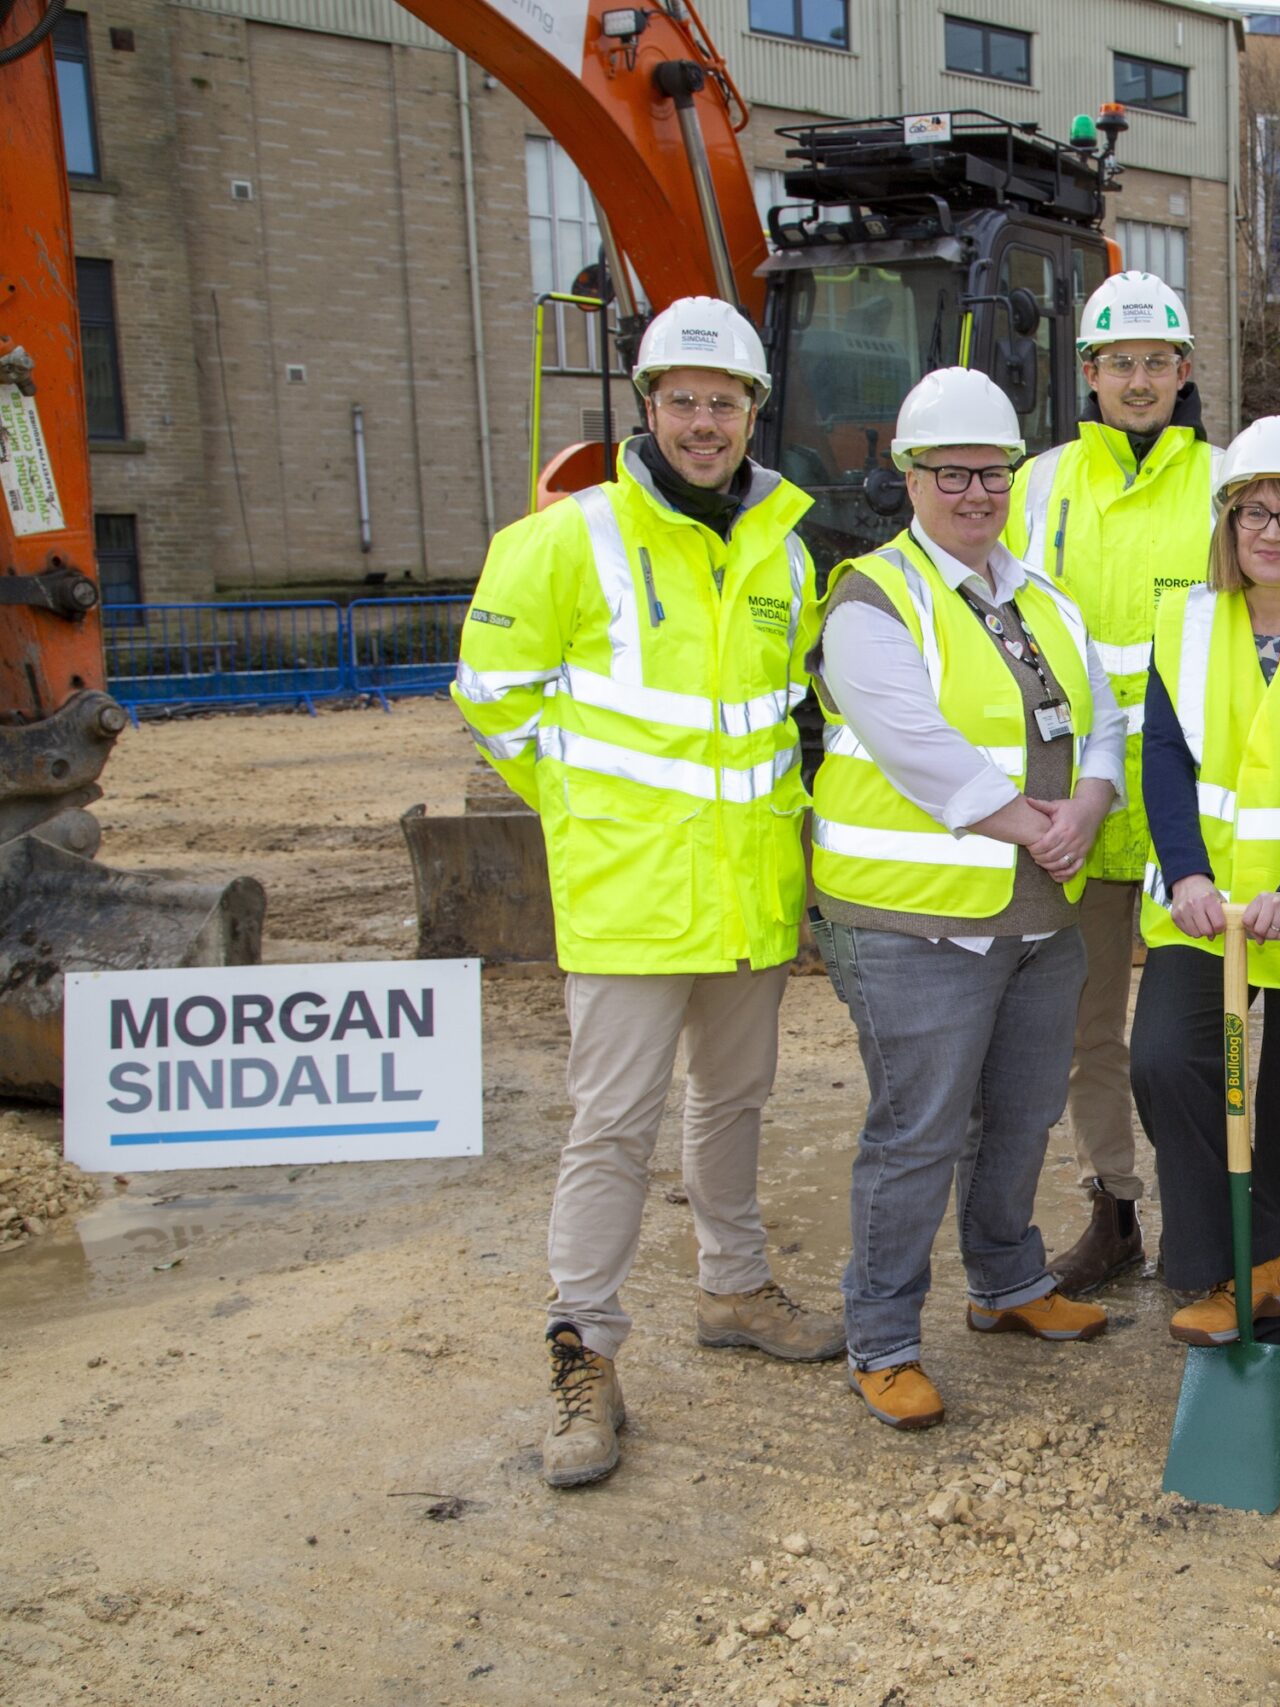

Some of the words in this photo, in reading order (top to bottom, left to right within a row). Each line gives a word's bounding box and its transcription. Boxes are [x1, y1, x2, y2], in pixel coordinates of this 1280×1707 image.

[681, 329, 718, 338] MORGAN
[681, 336, 716, 344] SINDALL
[28, 409, 41, 447] REQUIRED
[750, 606, 788, 623] SINDALL
[110, 988, 434, 1049] MORGAN
[1228, 1036, 1242, 1086] Bulldog
[107, 1052, 423, 1114] SINDALL
